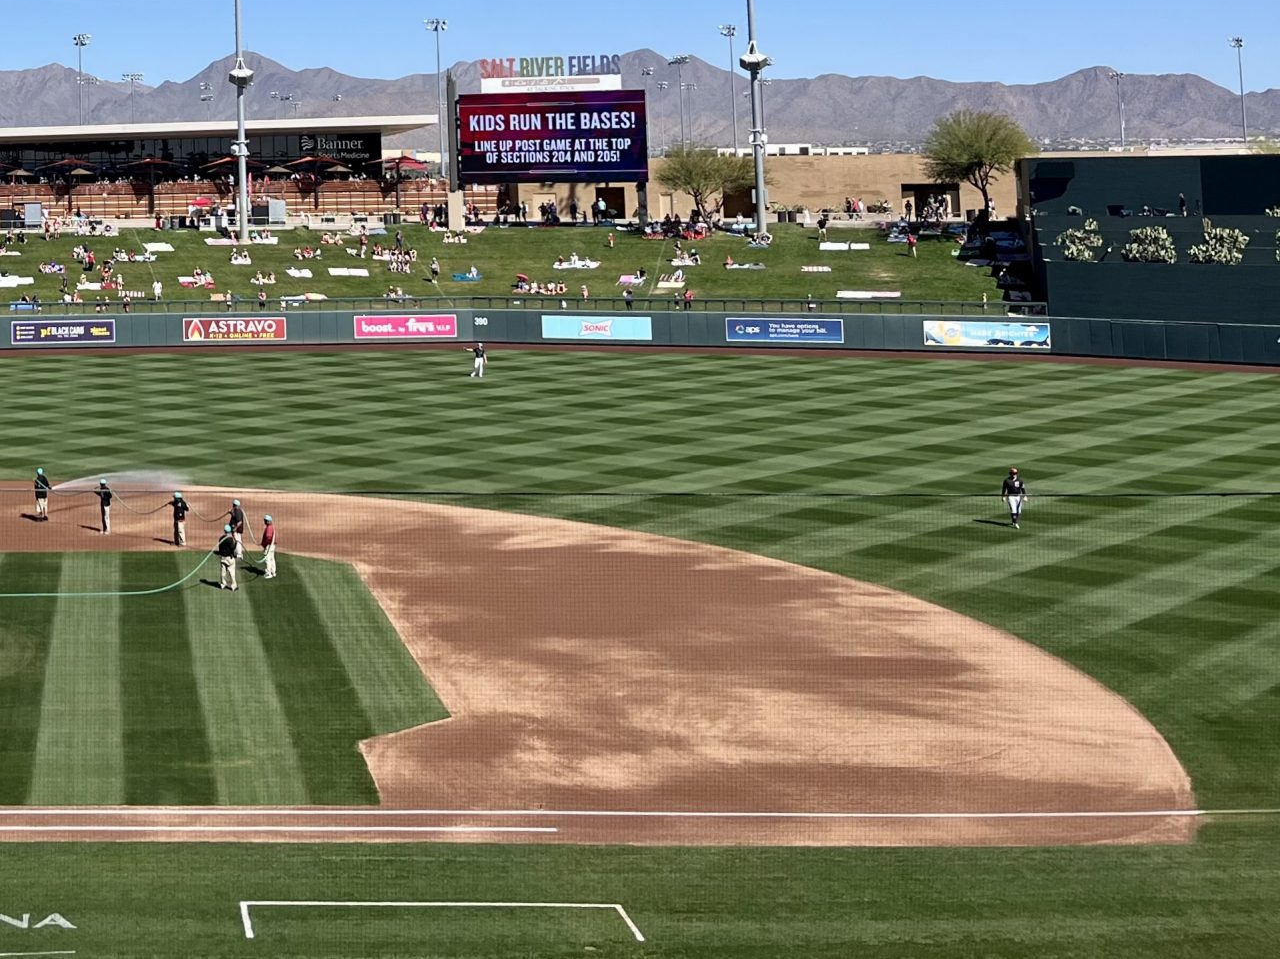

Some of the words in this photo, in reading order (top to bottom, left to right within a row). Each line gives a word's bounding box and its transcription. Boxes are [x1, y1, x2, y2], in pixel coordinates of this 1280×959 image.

[480, 58, 516, 79] SALT
[520, 56, 564, 77] RIVER
[568, 54, 621, 76] FIELDS
[469, 115, 505, 131] KIDS
[509, 113, 541, 131] RUN
[545, 112, 576, 130] THE
[580, 111, 636, 129] BASES!
[316, 137, 364, 150] Banner
[474, 141, 497, 152] LINE
[499, 140, 513, 151] UP
[515, 140, 541, 151] POST
[543, 139, 572, 151] GAME
[574, 139, 587, 150] AT
[589, 138, 608, 150] THE
[610, 138, 631, 150] TOP
[486, 152, 498, 164] OF
[501, 151, 550, 163] SECTIONS
[552, 151, 572, 163] 204
[574, 150, 595, 162] AND
[597, 150, 620, 162] 205!
[208, 320, 277, 333] ASTRAVO
[474, 317, 489, 326] 390
[583, 324, 609, 332] SONIC
